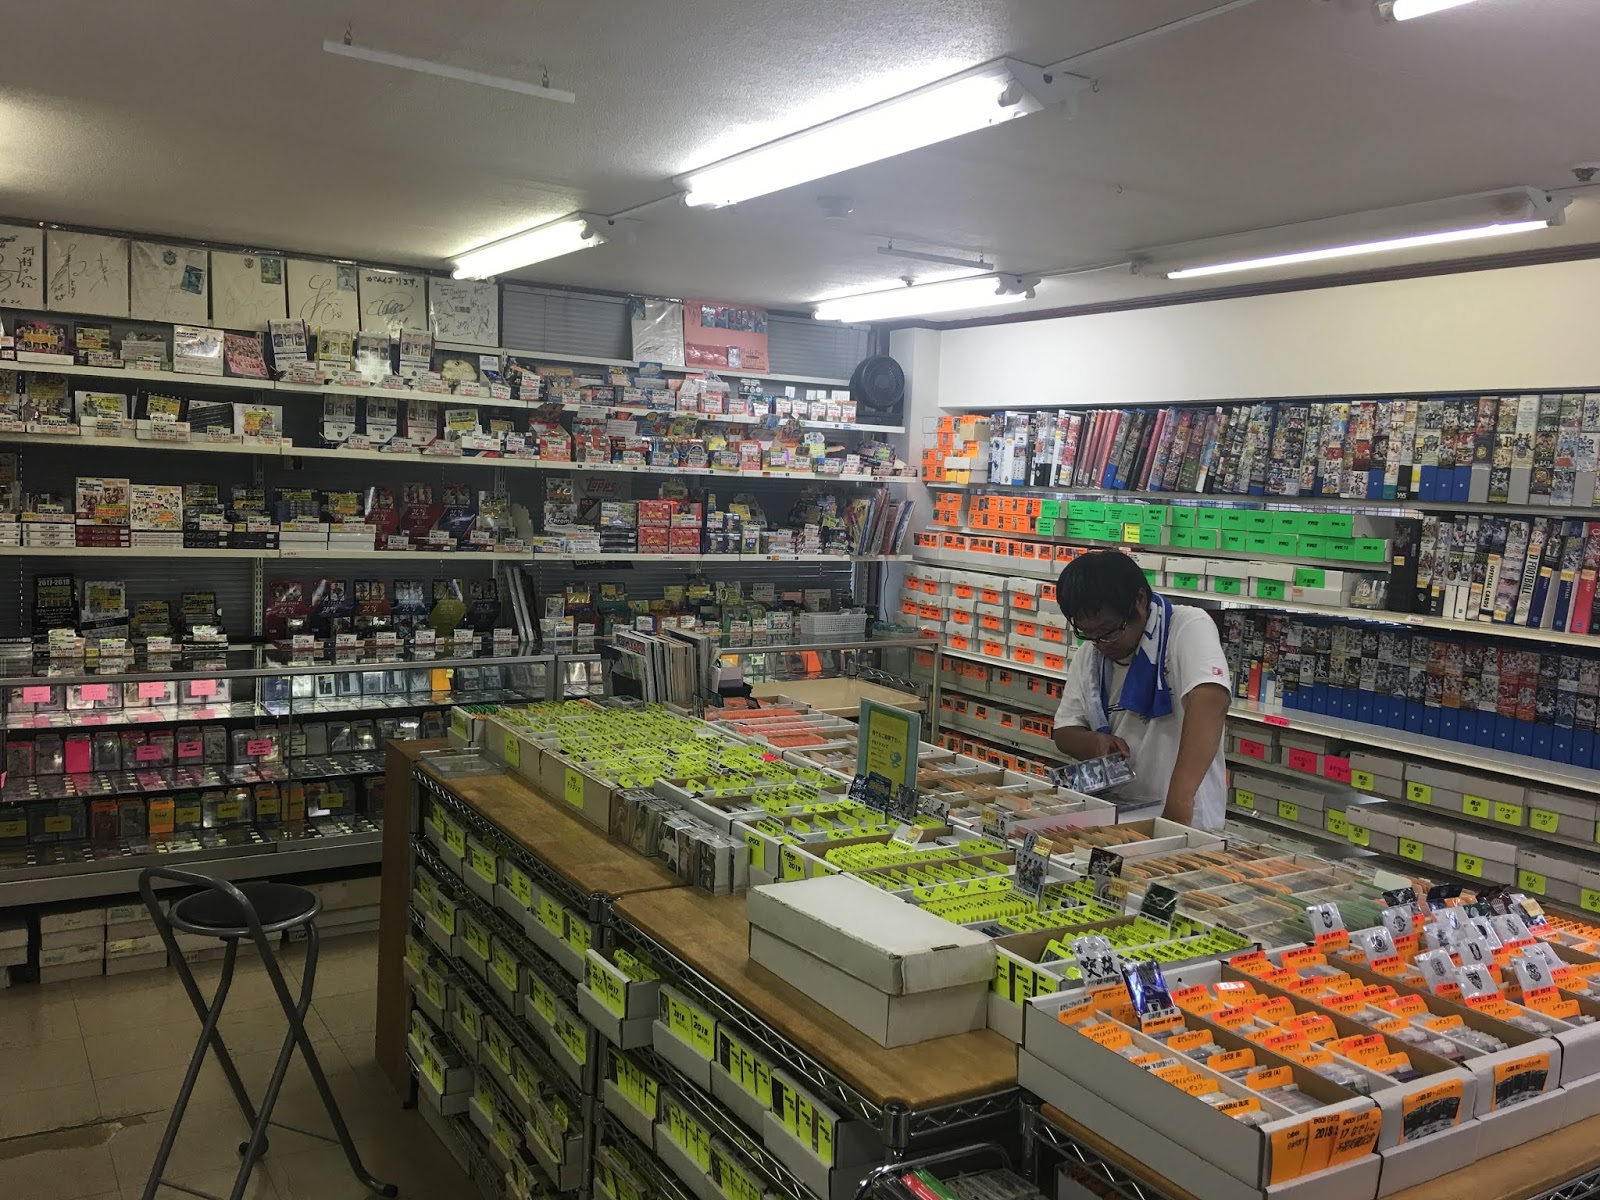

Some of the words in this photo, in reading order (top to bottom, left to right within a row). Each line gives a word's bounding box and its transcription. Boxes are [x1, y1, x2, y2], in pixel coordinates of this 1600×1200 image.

[1485, 565, 1495, 589] OFFICIAL
[1521, 560, 1537, 595] FOOTBALL
[1483, 590, 1492, 608] CARDS
[1500, 807, 1517, 815] ロッテ
[1329, 817, 1346, 826] ヤクルト
[1536, 813, 1553, 821] ロッテ
[1526, 876, 1537, 884] 巨人
[1111, 884, 1128, 893] NEW
[1589, 894, 1600, 902] 巨人
[607, 984, 618, 995] 2017
[1186, 995, 1203, 1003] サブセット
[1197, 1003, 1215, 1012] レギュラー
[1267, 1007, 1286, 1015] サブセット
[1339, 1003, 1358, 1011] サブセット
[1480, 1003, 1498, 1011] サブセット
[1552, 1003, 1572, 1011] レギュラー
[1494, 1008, 1513, 1016] レギュラー
[1226, 1017, 1245, 1025] サブセット
[1380, 1021, 1400, 1030] レギュラー
[1435, 1018, 1454, 1026] レギュラー
[693, 1022, 708, 1036] 2018
[1306, 1026, 1325, 1034] サブセット
[1253, 1030, 1272, 1039] レギュラー
[1280, 1043, 1300, 1052] サブセット
[1359, 1046, 1379, 1055] サブセット
[1302, 1054, 1323, 1063] レギュラー
[1375, 1057, 1396, 1066] レギュラー
[1217, 1102, 1238, 1111] SAMURAI
[1238, 1099, 1250, 1108] BLUE
[1314, 1126, 1334, 1140] 2018
